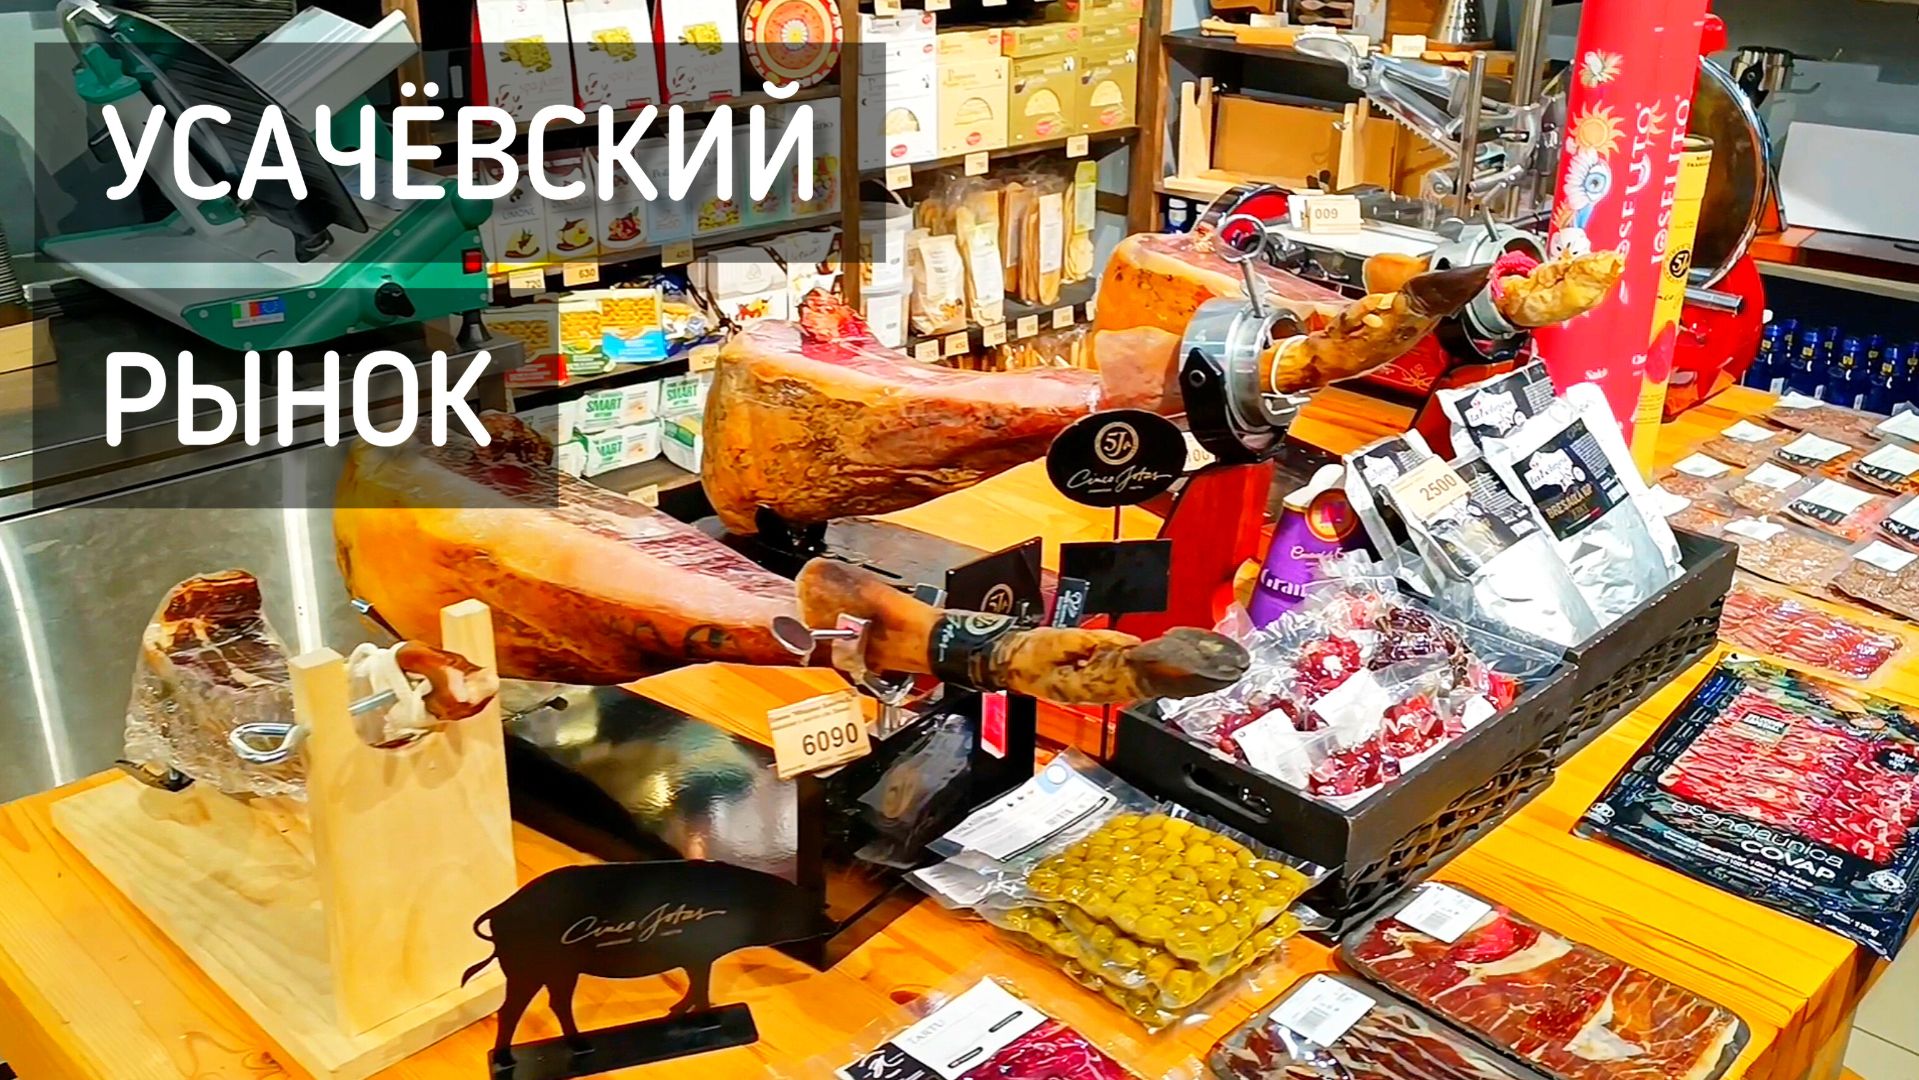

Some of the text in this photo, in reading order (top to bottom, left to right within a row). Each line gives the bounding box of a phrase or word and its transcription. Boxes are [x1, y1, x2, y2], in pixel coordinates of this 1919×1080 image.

[578, 268, 596, 279] 630
[585, 397, 622, 413] SMART
[666, 385, 698, 402] SMART
[1066, 468, 1114, 489] Cinco
[1418, 473, 1459, 502] 2500
[802, 722, 859, 756] 6090
[1739, 839, 1837, 880] COVAP
[561, 902, 727, 945] Cinco Jotas
